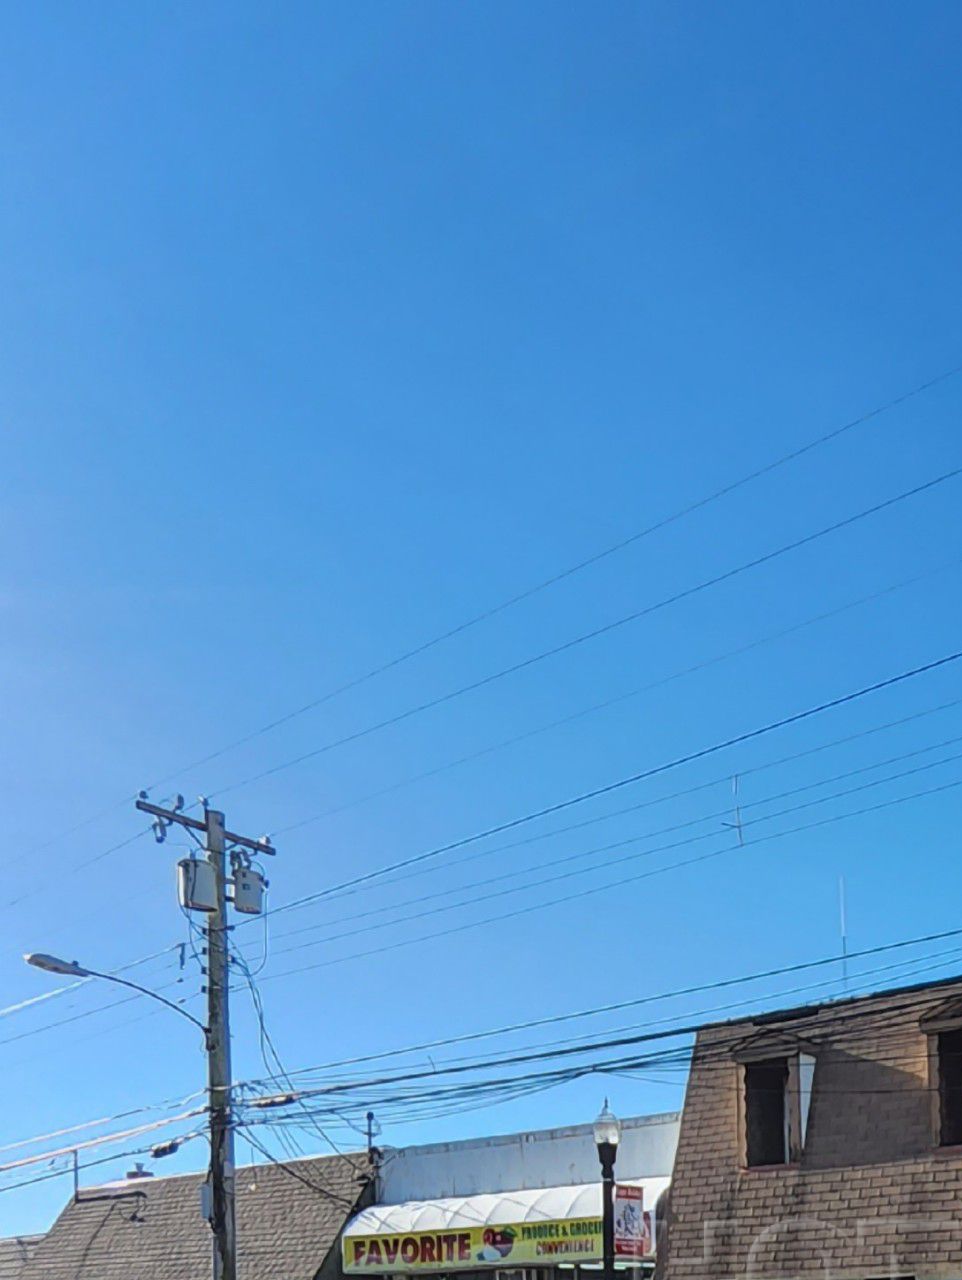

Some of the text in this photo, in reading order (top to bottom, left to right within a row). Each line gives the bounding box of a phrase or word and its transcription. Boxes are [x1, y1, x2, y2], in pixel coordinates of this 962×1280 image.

[521, 1223, 559, 1240] PRODUCE
[562, 1225, 569, 1237] &
[353, 1232, 471, 1267] FAVORITE
